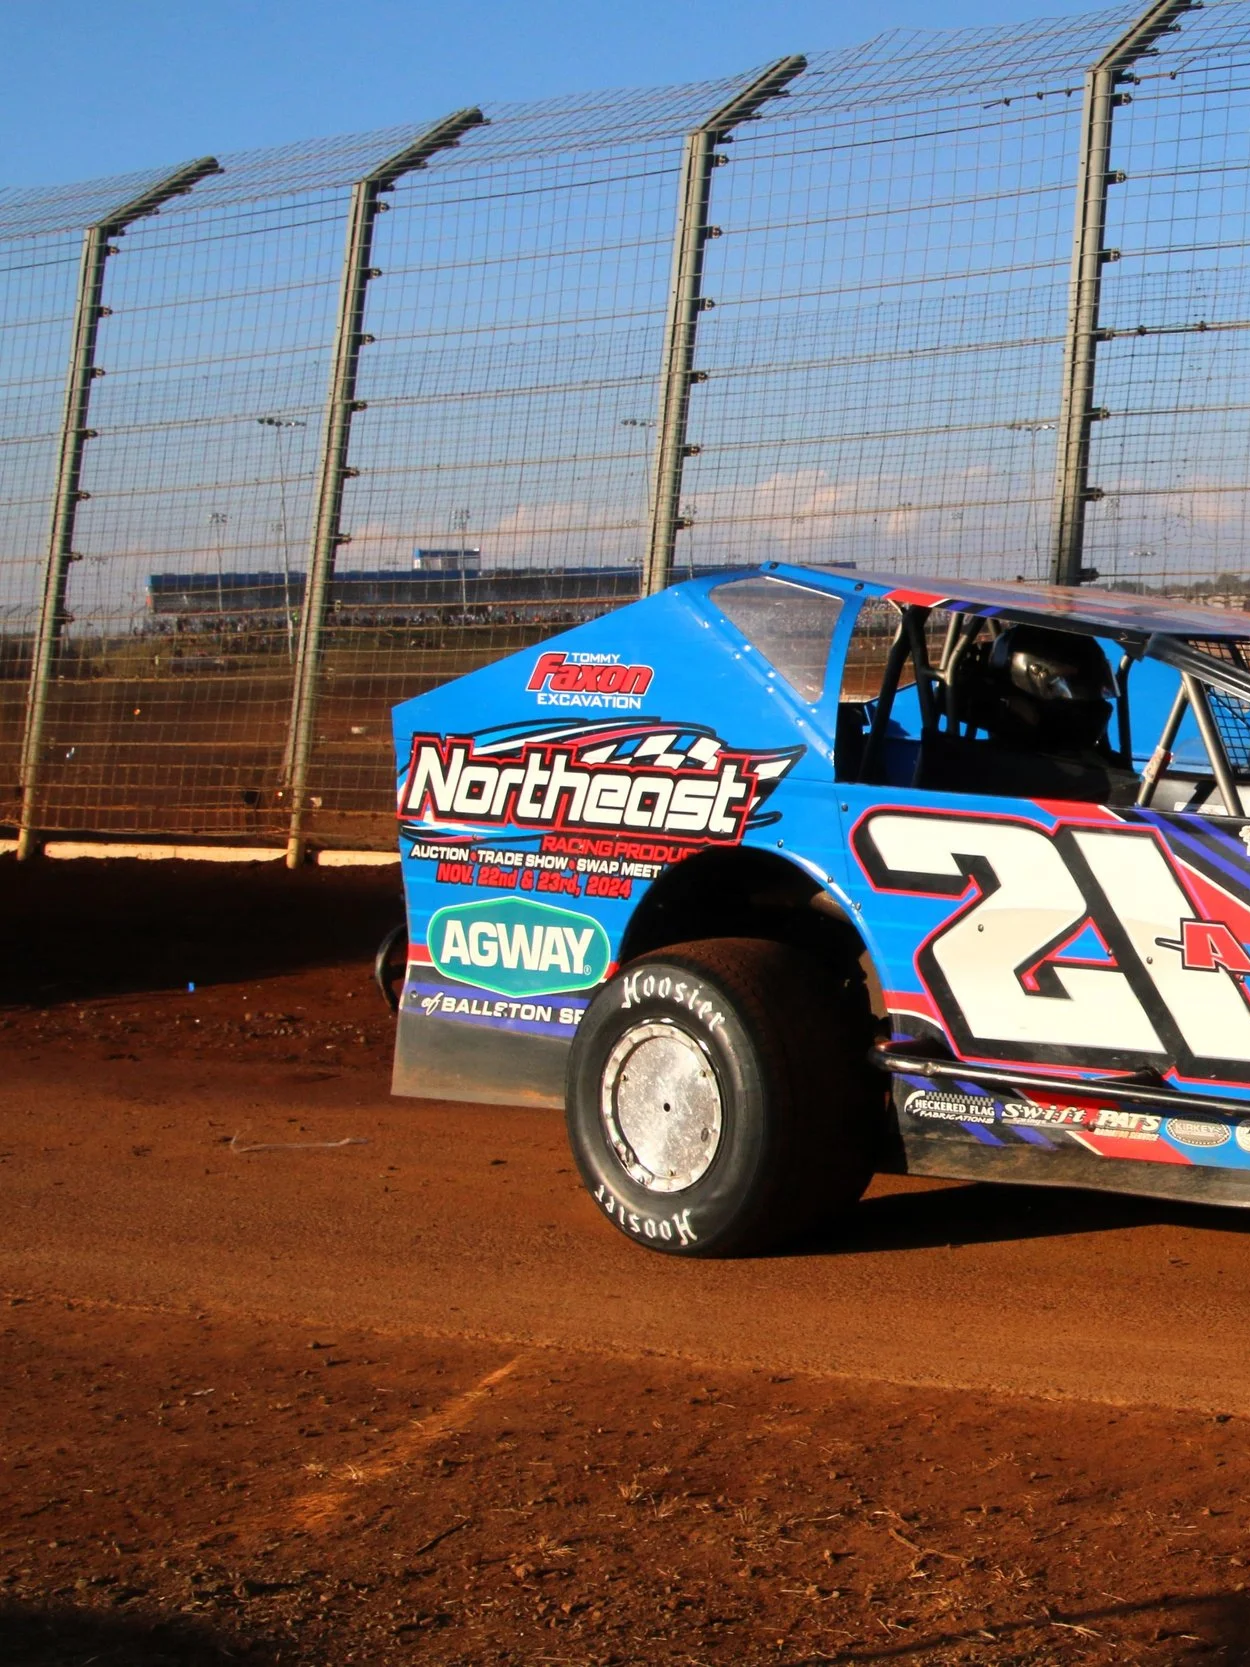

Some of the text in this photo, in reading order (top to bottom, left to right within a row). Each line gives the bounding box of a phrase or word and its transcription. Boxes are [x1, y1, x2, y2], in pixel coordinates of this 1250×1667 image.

[529, 653, 654, 694] Faxon
[572, 652, 621, 663] TOMMY
[536, 693, 641, 709] EXCAVATION
[404, 744, 750, 835] Northeast
[410, 844, 662, 879] AUCTION TRADE SHOW SWAP MEET
[541, 837, 613, 858] RACING
[437, 864, 632, 899] NOV. 22nd & 23rd, 2024
[440, 919, 596, 974] AGWAY
[421, 996, 439, 1018] of
[441, 997, 551, 1024] BALLSTON
[621, 970, 727, 1032] Hoosier
[918, 1110, 995, 1125] FABRICATIONS
[968, 1105, 995, 1117] FLAG
[594, 1183, 698, 1247] Hoosier
